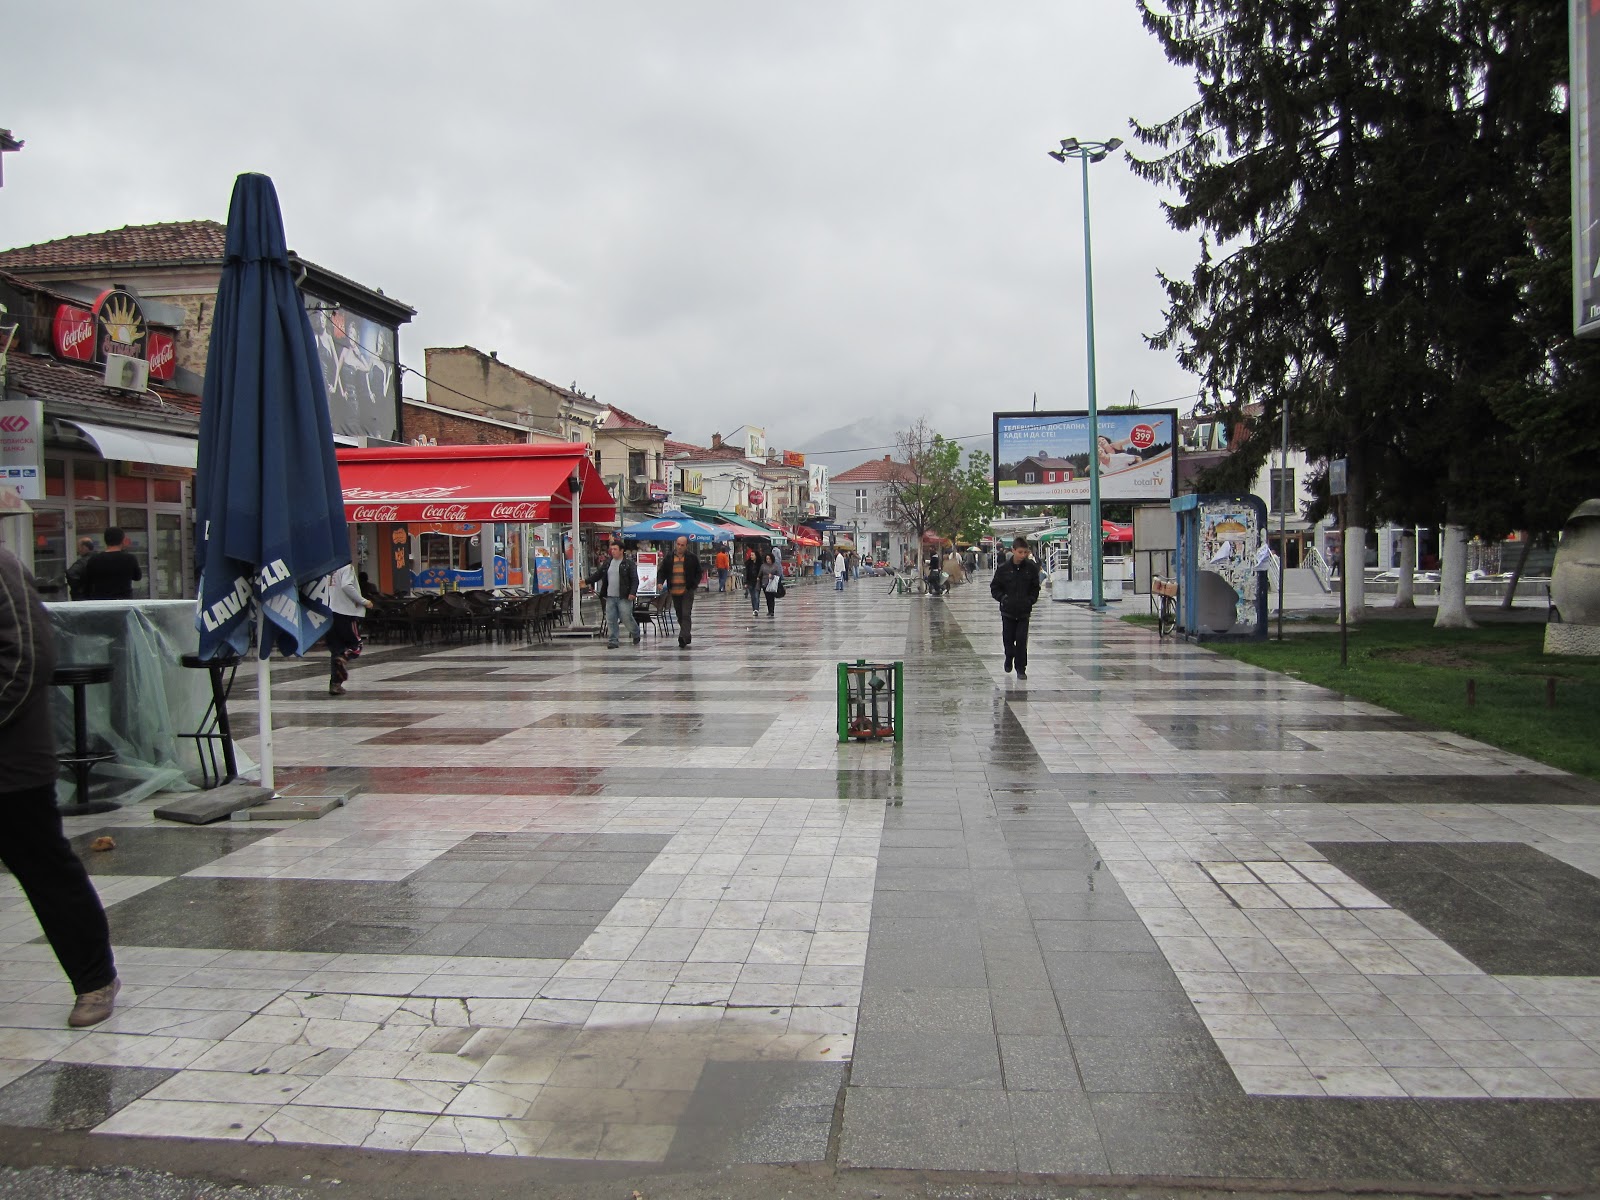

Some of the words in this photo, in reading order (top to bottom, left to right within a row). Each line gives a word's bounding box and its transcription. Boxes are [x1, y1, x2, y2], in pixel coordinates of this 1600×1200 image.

[62, 317, 92, 351] Coca-Cola
[149, 342, 173, 372] Coca-Cola
[1003, 431, 1022, 439] КАДЕ
[1047, 423, 1086, 431] ДОСТАПНА
[1134, 432, 1151, 441] 399
[1133, 478, 1164, 486] totalTV
[353, 505, 400, 522] Coca-Cola
[421, 504, 470, 521] Coca-Cola
[491, 502, 539, 519] Coca-Cola
